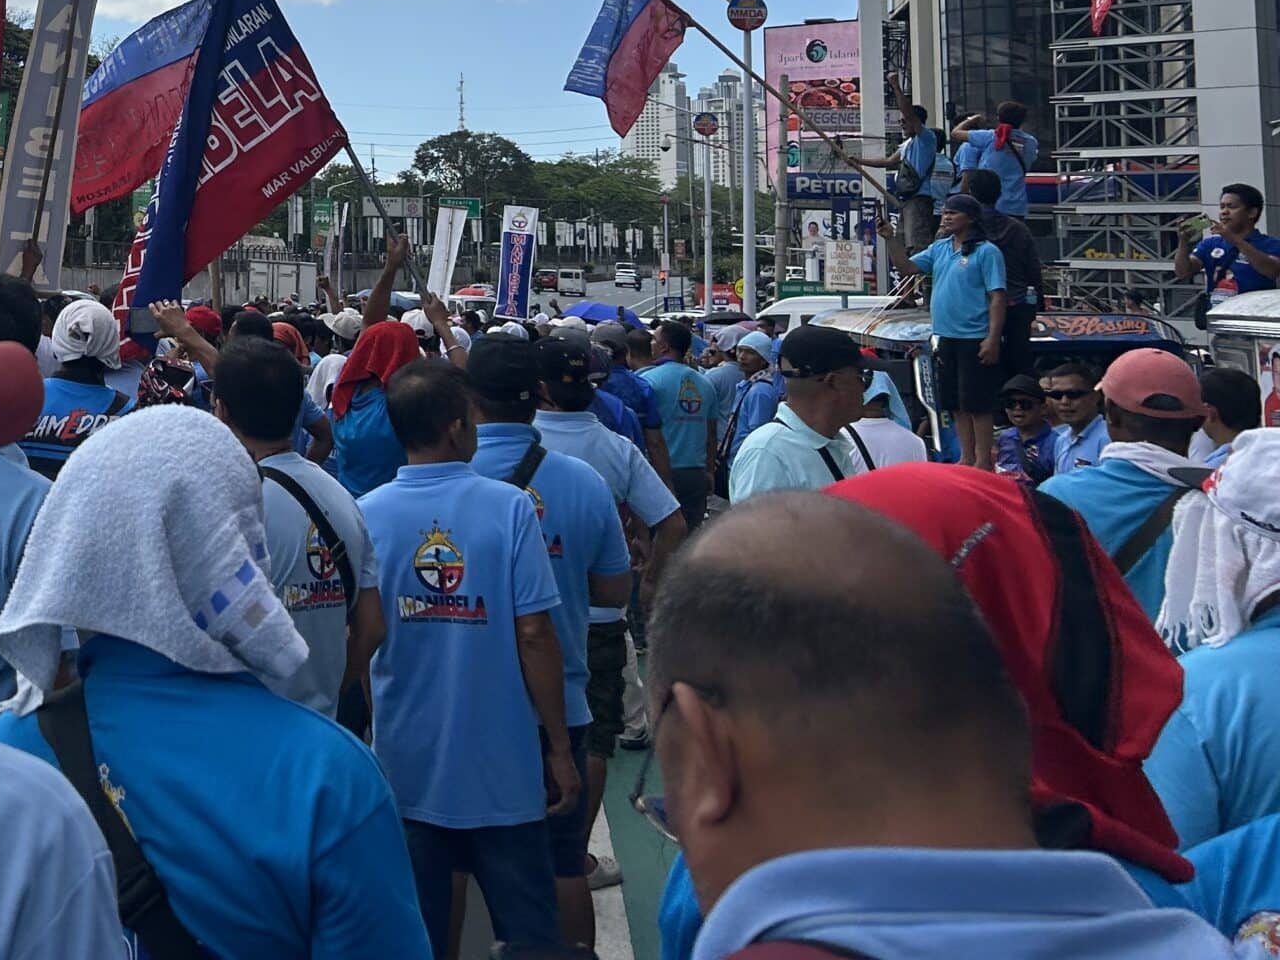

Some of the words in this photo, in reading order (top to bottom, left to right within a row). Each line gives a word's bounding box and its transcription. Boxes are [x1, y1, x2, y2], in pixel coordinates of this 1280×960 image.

[730, 8, 765, 20] MMDA
[261, 171, 292, 199] MAR
[795, 176, 862, 194] PETRO
[835, 242, 853, 251] NO
[505, 233, 527, 316] MANIBELA
[1065, 315, 1148, 337] Blessing
[397, 594, 488, 619] MANIBELA
